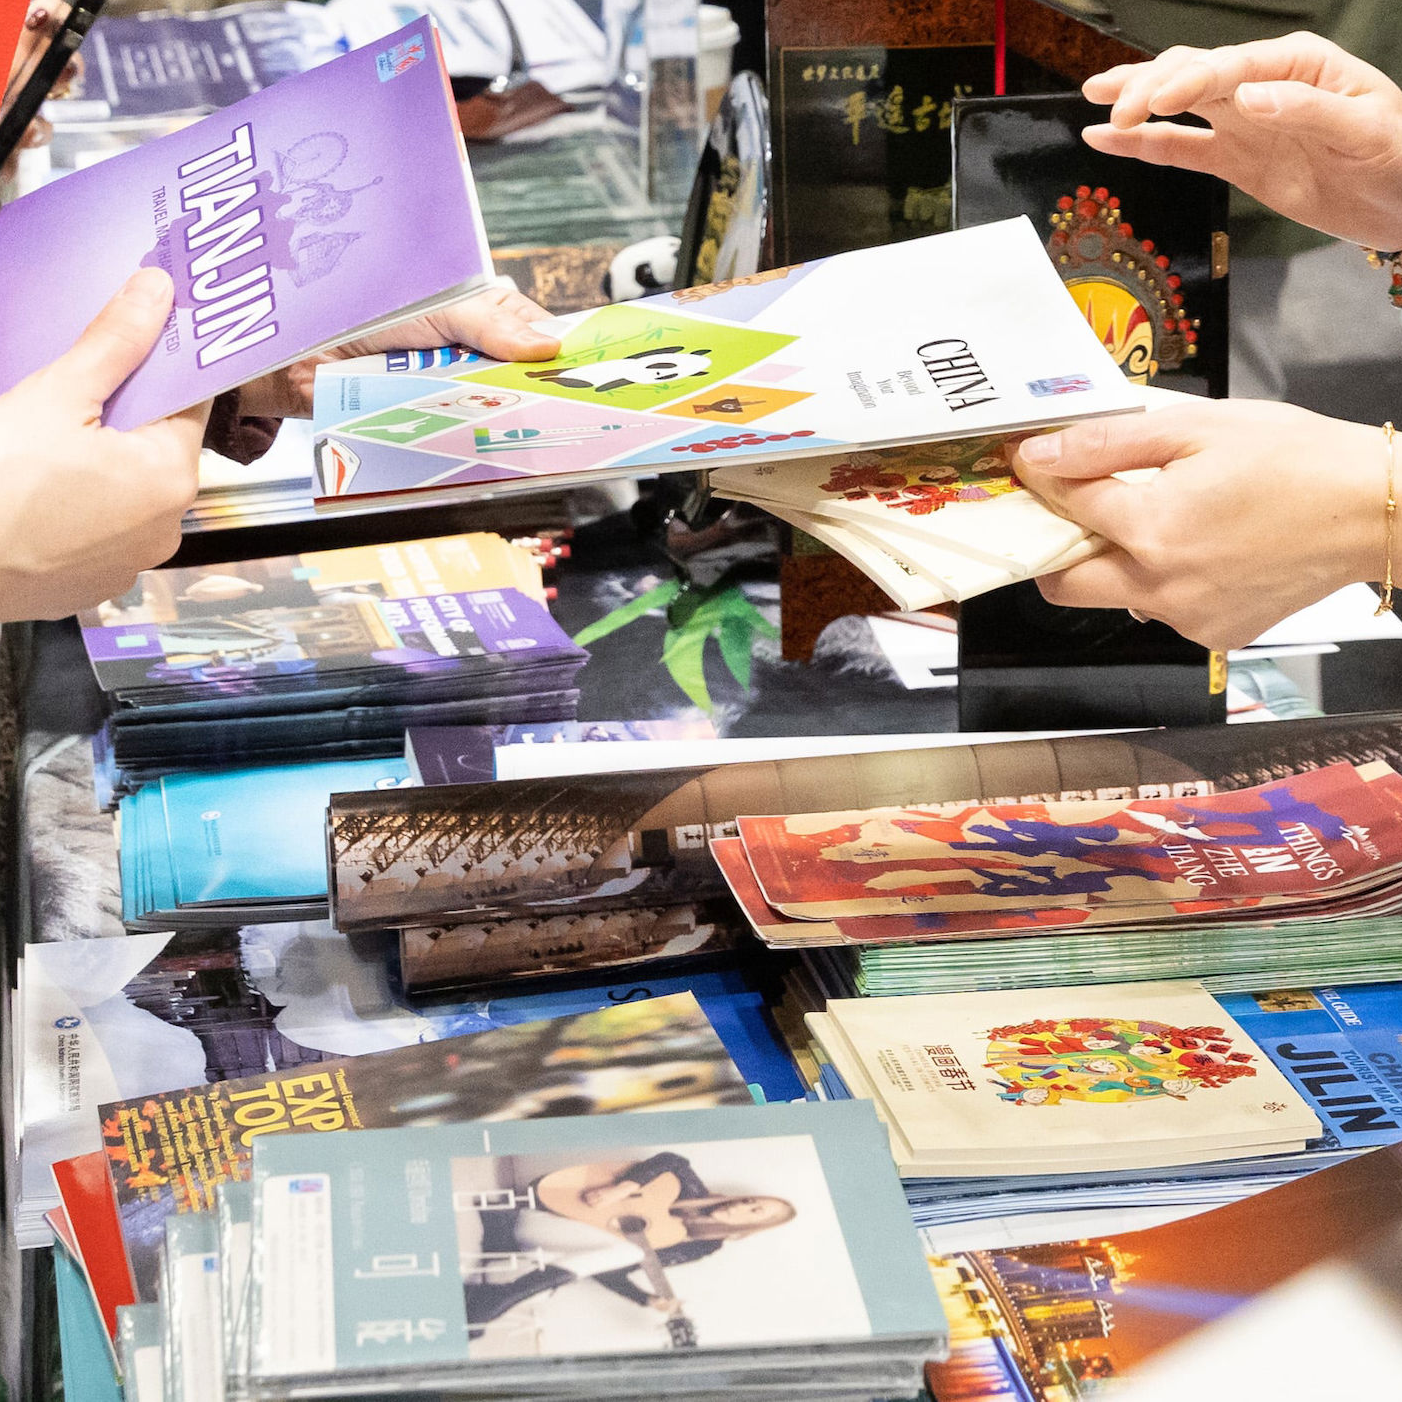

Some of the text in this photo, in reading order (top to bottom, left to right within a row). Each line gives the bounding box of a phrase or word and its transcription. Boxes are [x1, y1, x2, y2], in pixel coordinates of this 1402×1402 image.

[152, 186, 168, 226] TRAVEL
[156, 223, 171, 248] MAP
[178, 122, 280, 369] TIANJIN
[846, 370, 877, 410] Imagination
[876, 378, 895, 395] Your
[897, 370, 926, 396] Beyond
[917, 339, 1001, 412] CHINA
[1162, 843, 1217, 887] JIANG
[1203, 847, 1250, 878] ZHE
[1279, 822, 1345, 881] THINGS
[1332, 999, 1363, 1027] GUIDE
[922, 1044, 977, 1091] 漫画春节
[1276, 1043, 1401, 1133] JILIN
[1341, 1049, 1382, 1086] TOURIST
[1373, 1084, 1399, 1105] MAP
[280, 1071, 347, 1133] EXP
